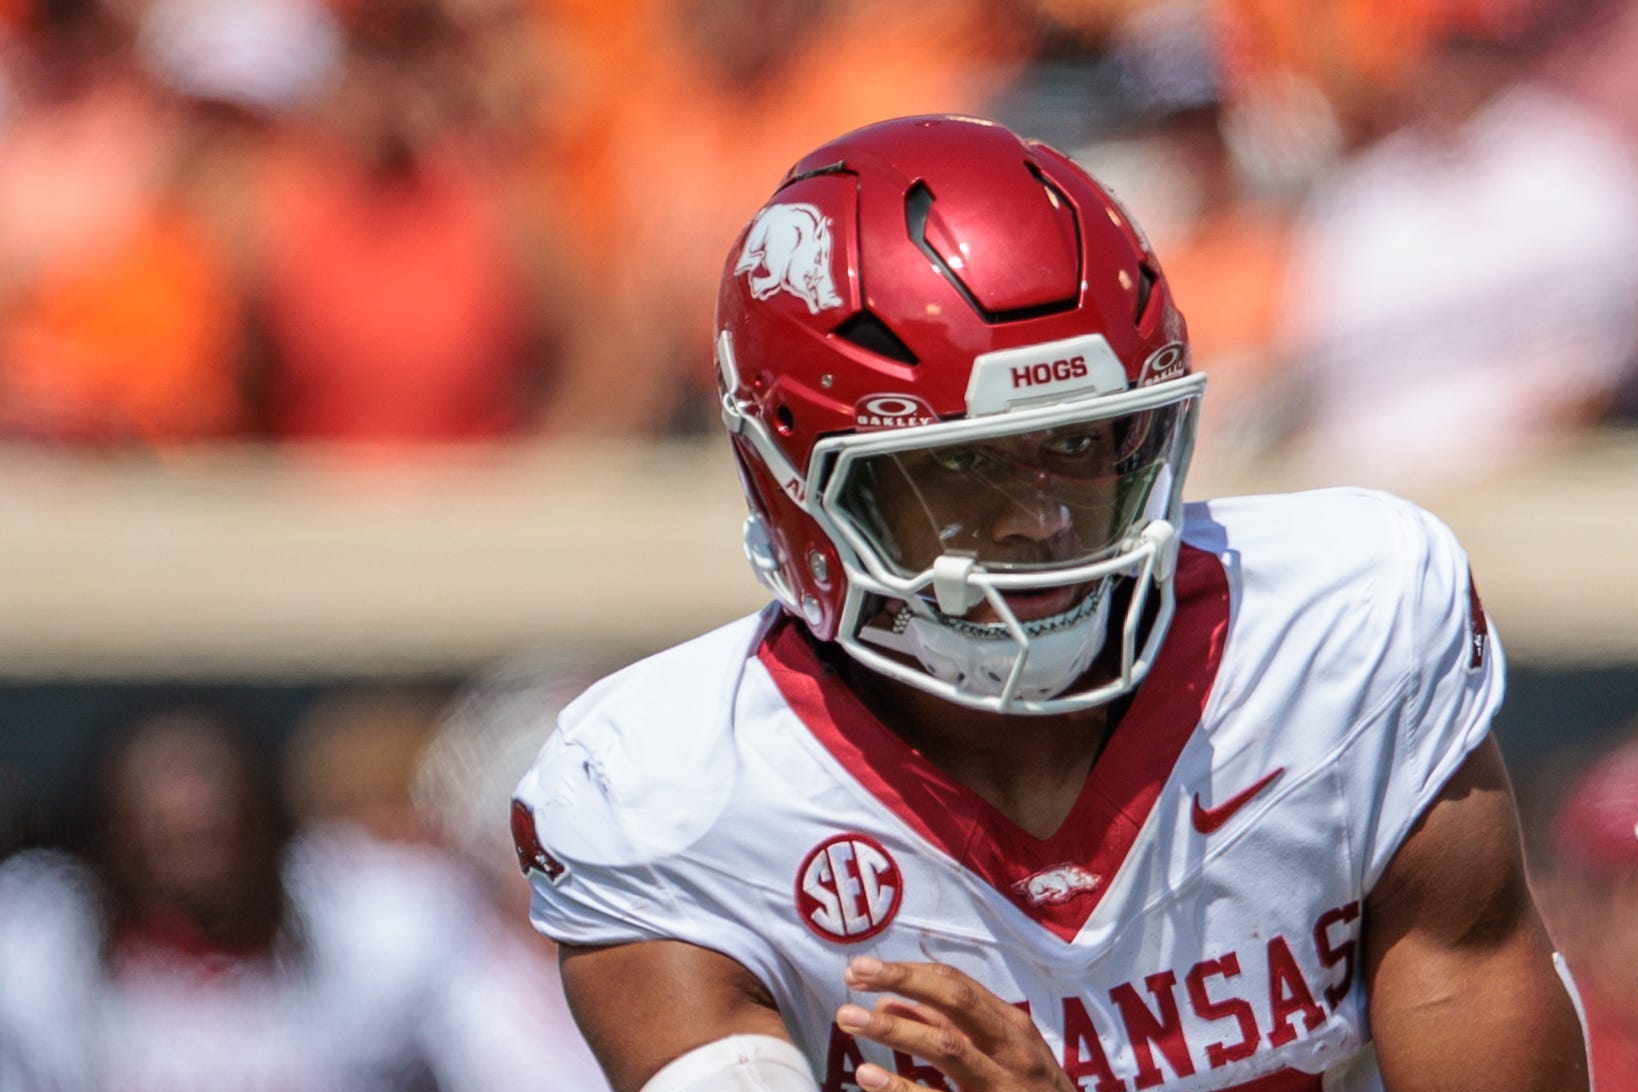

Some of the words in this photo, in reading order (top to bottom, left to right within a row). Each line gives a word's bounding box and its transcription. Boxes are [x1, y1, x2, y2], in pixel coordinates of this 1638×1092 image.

[1010, 355, 1088, 388] HOGS
[857, 415, 933, 426] OAKLEY
[802, 840, 896, 936] SEC
